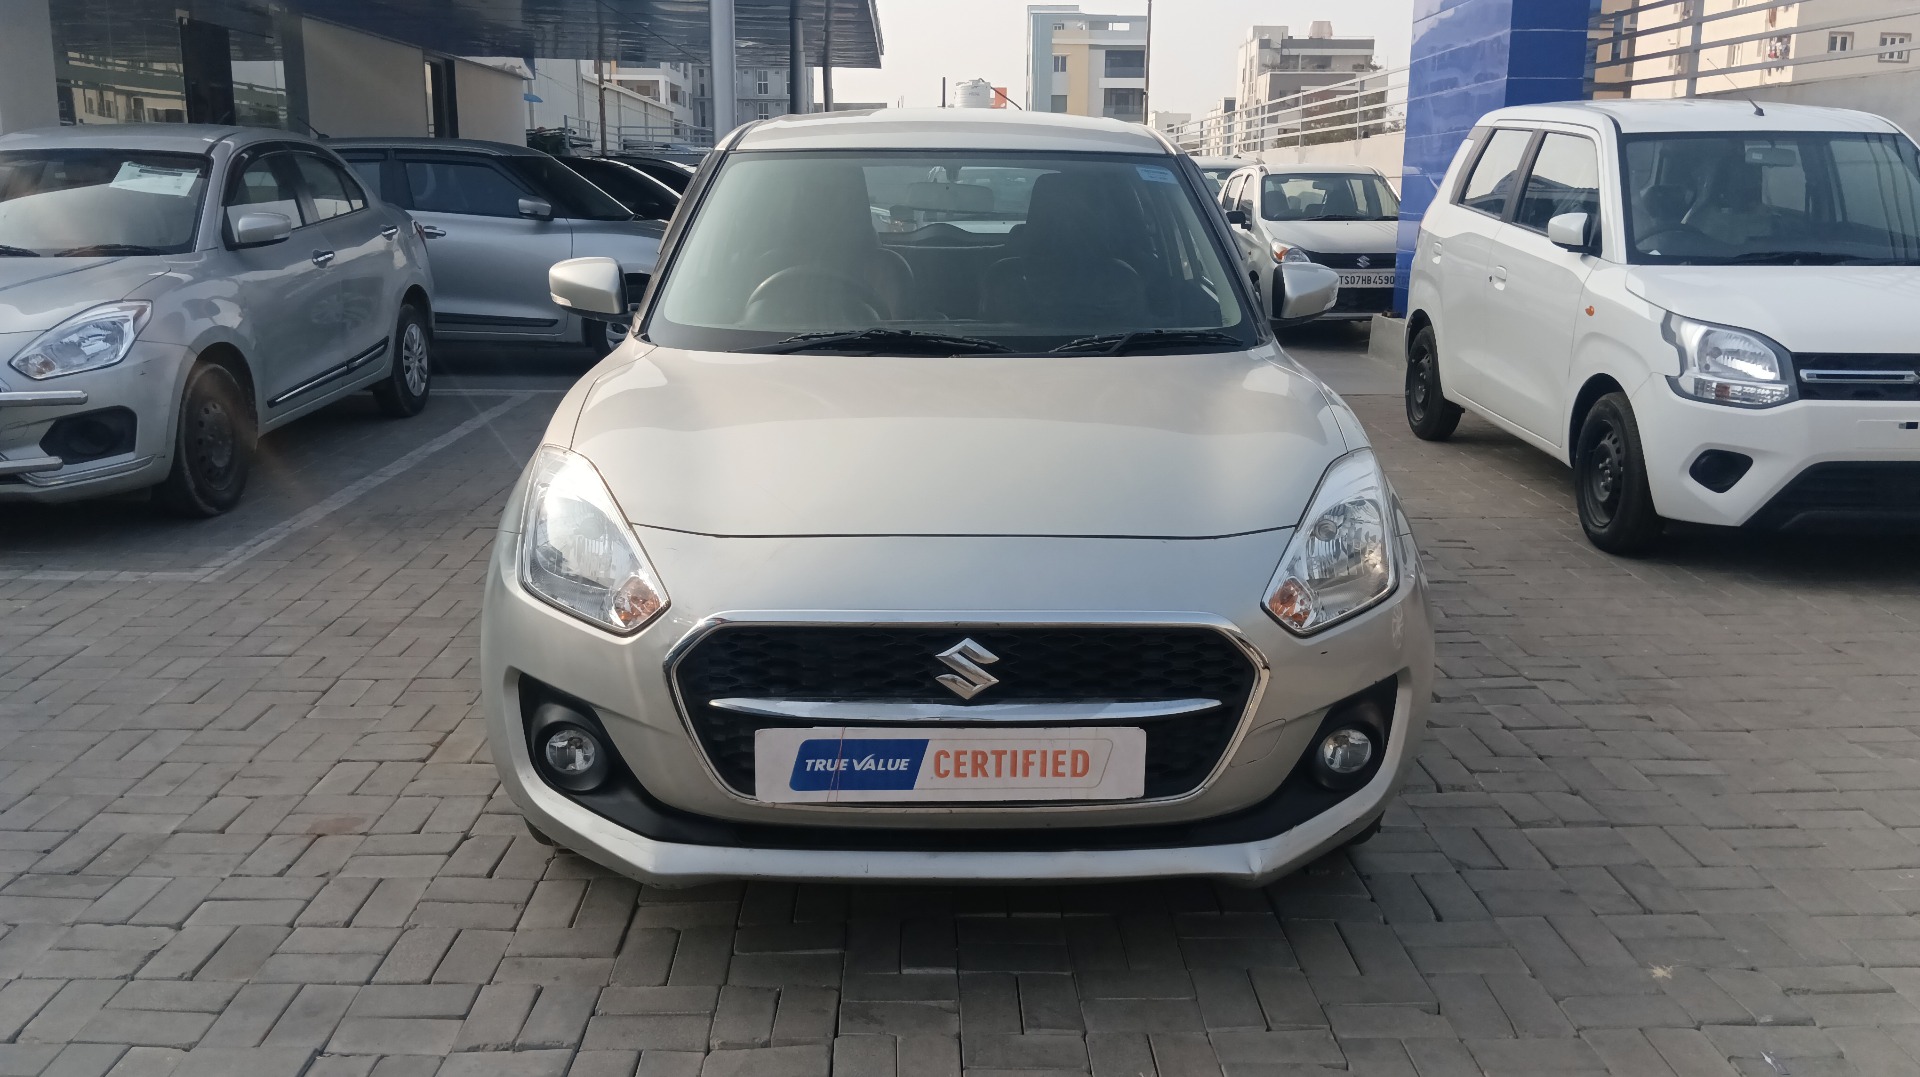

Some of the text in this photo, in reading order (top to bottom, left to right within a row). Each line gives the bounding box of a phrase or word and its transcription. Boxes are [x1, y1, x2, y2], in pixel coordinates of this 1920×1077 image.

[805, 749, 1090, 779] TRUE VALUE CERTIFIED
